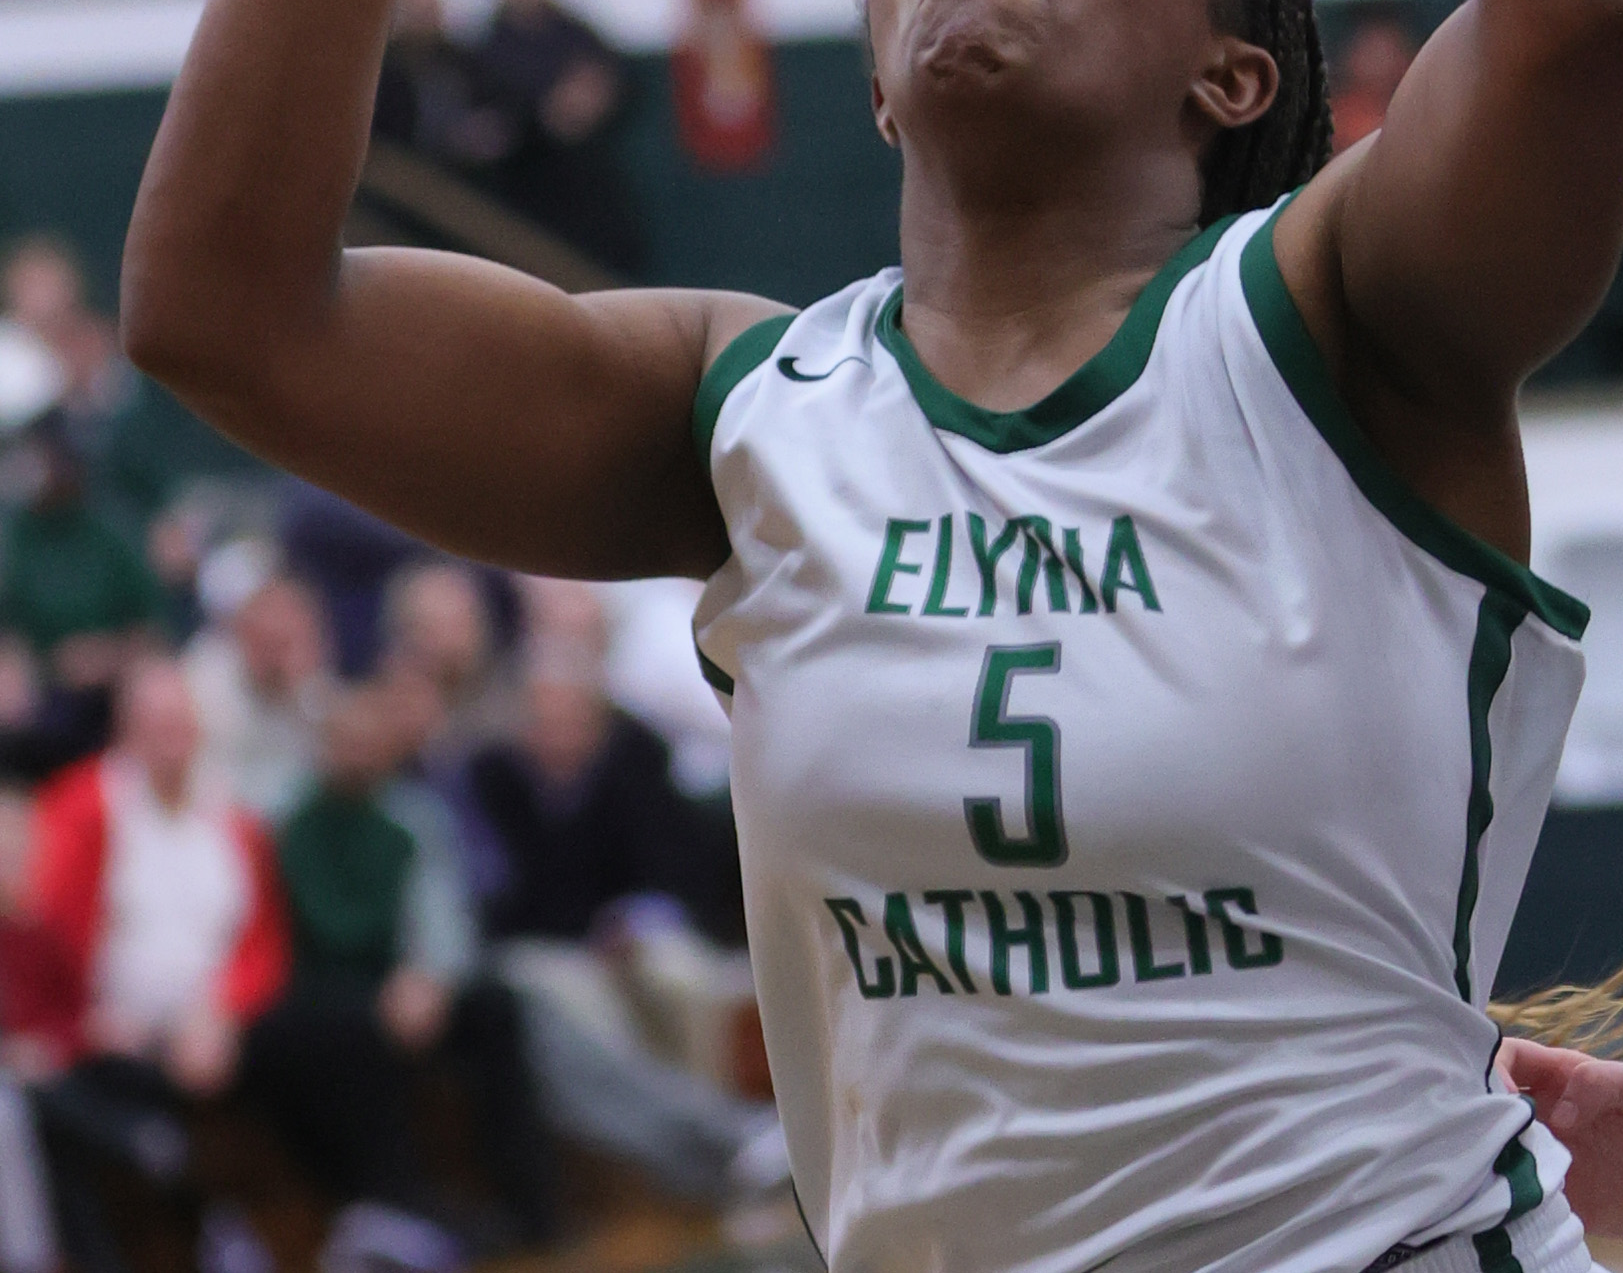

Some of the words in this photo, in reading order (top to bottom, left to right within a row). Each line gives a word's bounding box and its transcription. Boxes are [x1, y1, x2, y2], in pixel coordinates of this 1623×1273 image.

[864, 510, 1164, 618] ELYRIA
[963, 640, 1070, 870] 5
[823, 886, 1285, 1000] CATHOLIC
